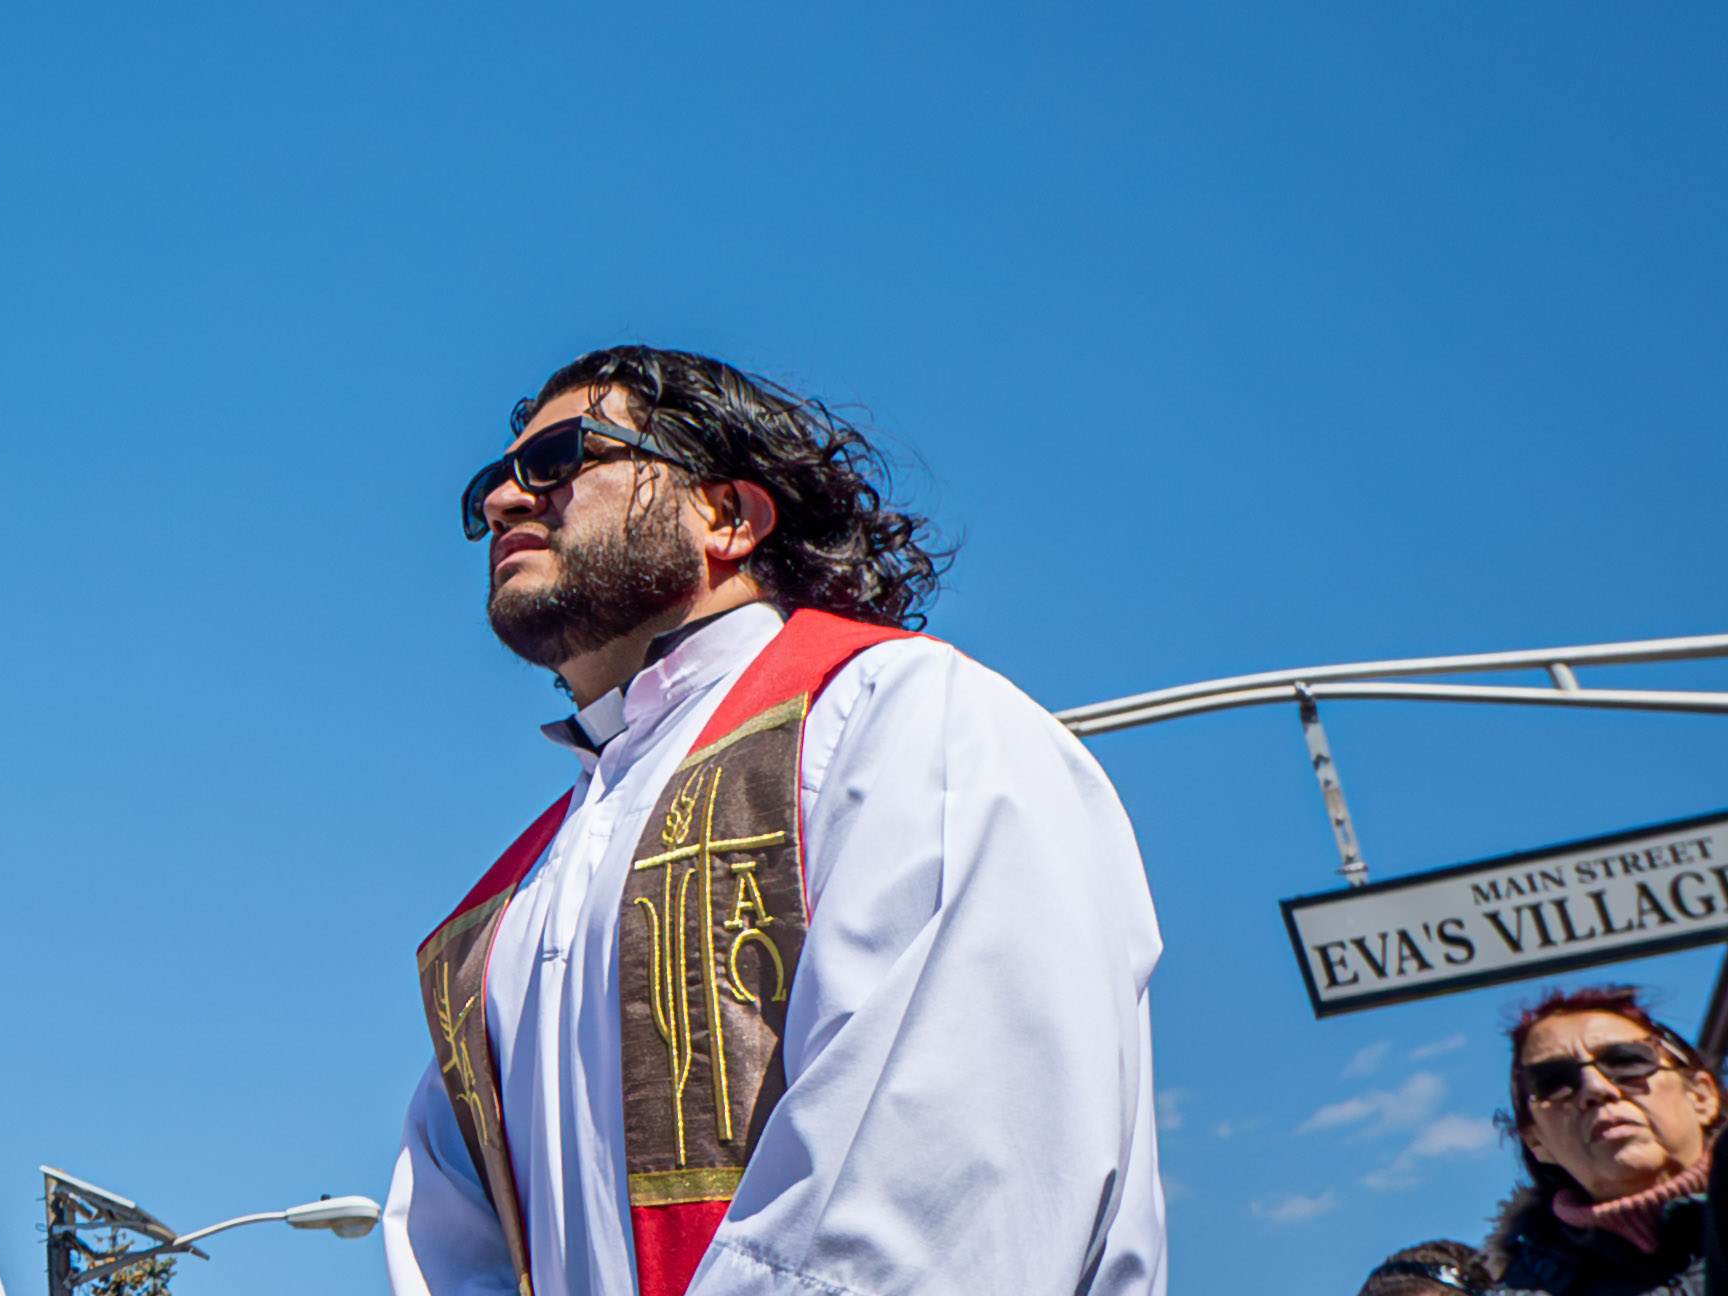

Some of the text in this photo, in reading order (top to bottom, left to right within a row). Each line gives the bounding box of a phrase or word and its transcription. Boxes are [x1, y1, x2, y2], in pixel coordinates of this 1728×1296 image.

[1470, 836, 1715, 905] MAIN STREET
[1312, 916, 1476, 990] EVA'S
